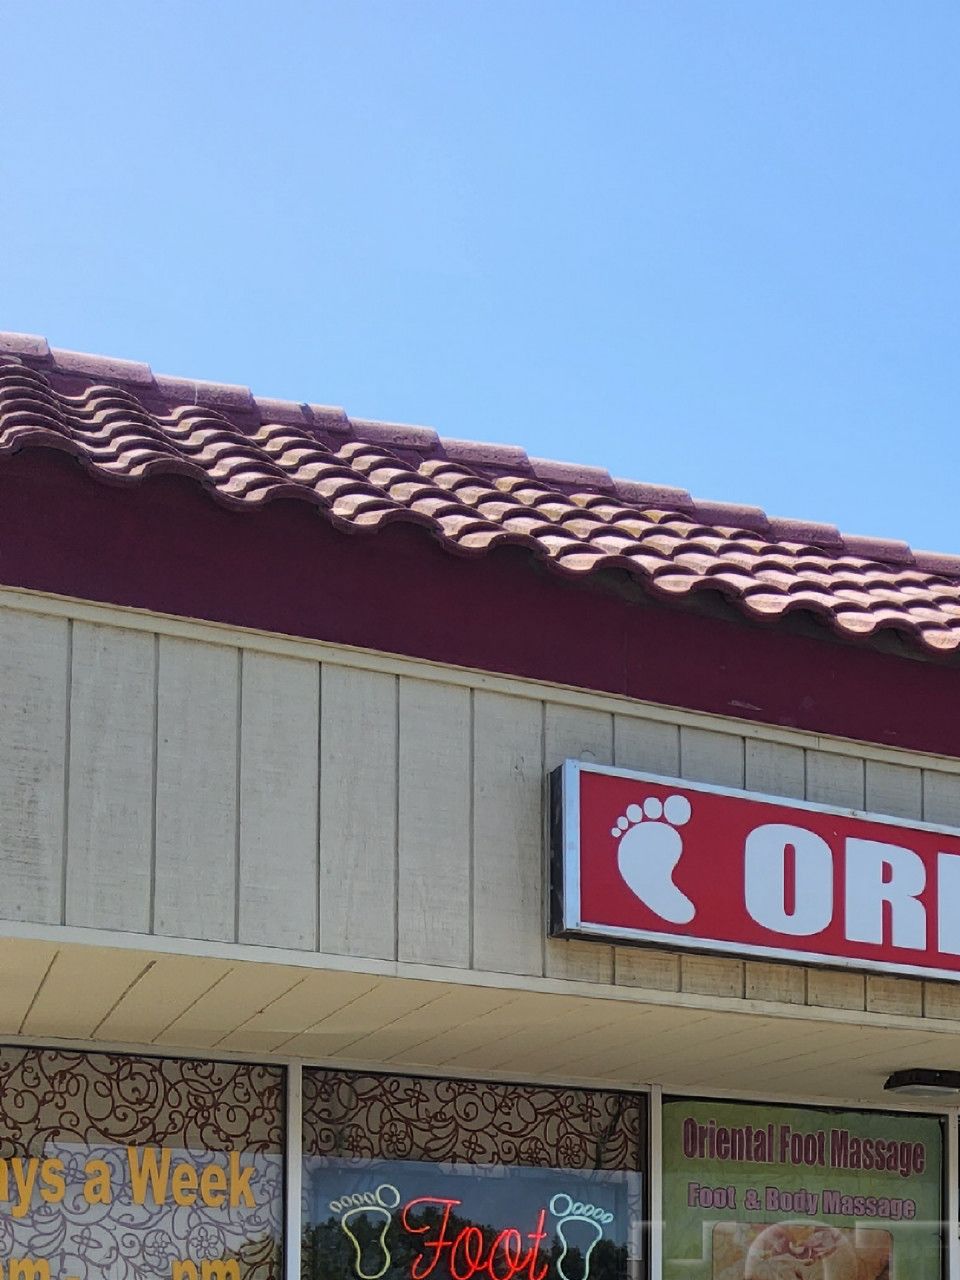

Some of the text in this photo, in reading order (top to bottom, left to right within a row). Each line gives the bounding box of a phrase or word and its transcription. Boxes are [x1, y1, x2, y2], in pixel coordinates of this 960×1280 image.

[682, 1117, 926, 1178] Oriental Foot Massage
[0, 1145, 256, 1218] ys a Week
[687, 1181, 916, 1220] Foot & Body Massage
